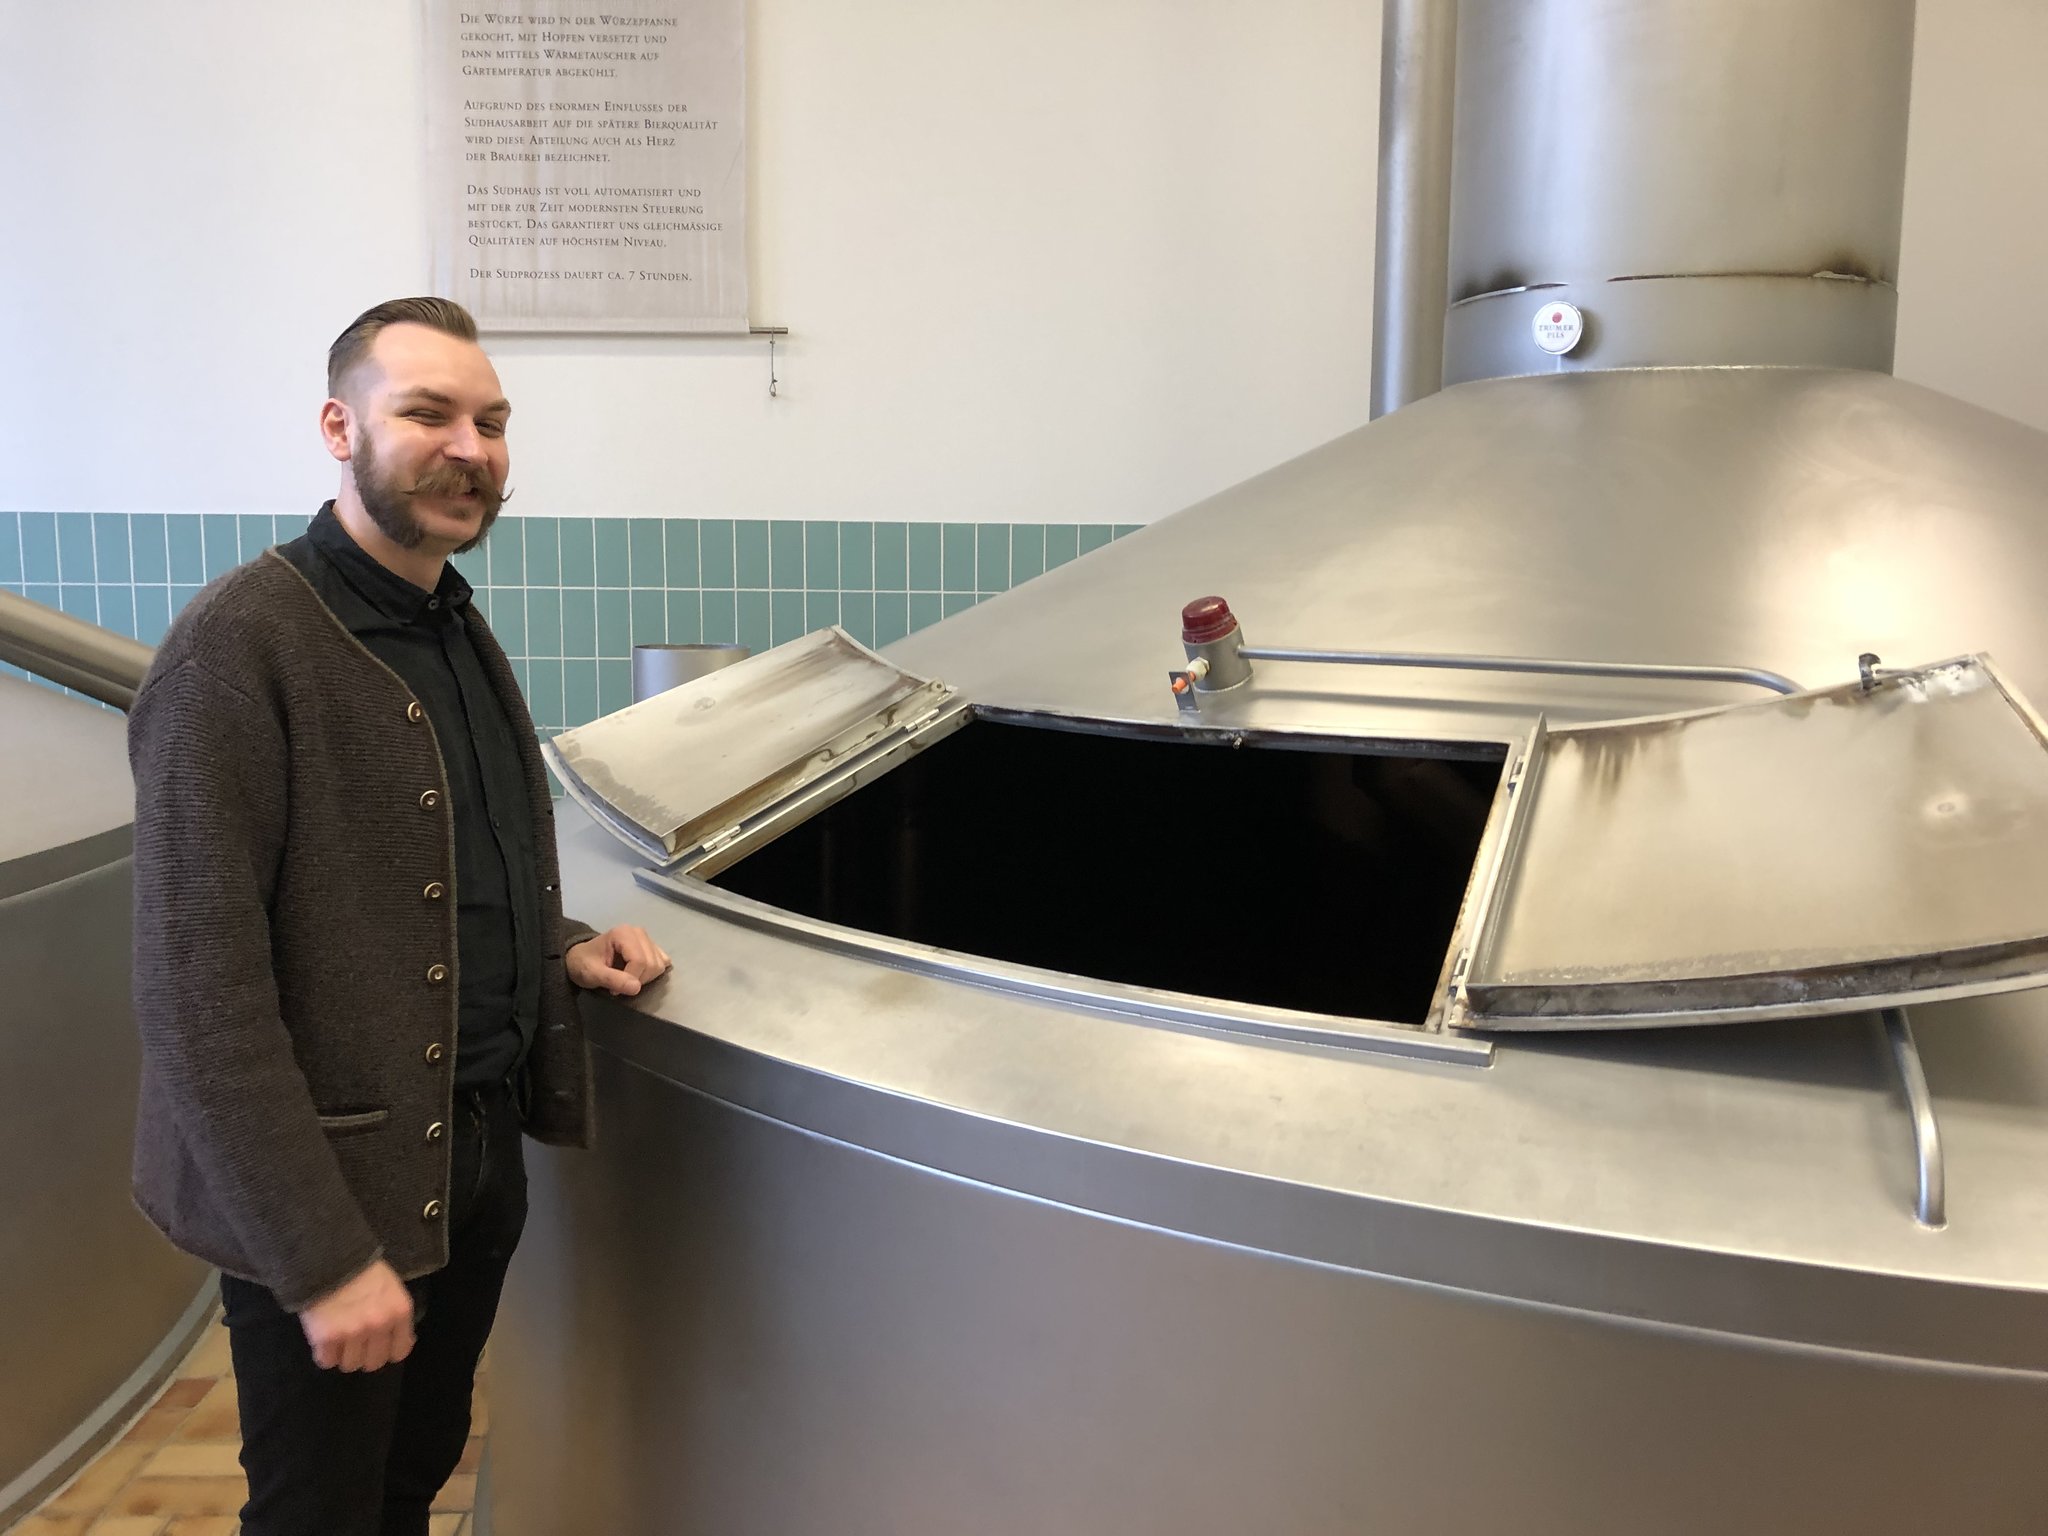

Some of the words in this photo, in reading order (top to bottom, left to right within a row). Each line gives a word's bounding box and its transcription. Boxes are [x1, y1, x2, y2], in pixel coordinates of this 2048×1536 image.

[461, 14, 479, 24] DIE
[560, 17, 570, 25] IN
[575, 17, 595, 25] DER
[518, 33, 537, 42] MIT
[542, 32, 585, 42] HOPFEN
[590, 35, 639, 43] VERSETZT
[644, 35, 667, 43] UND
[462, 50, 491, 58] DANN
[497, 51, 539, 59] MITTELS
[464, 100, 522, 111] AUFGRUND
[527, 102, 545, 111] DES
[550, 103, 599, 111] ENORMEN
[668, 104, 687, 112] DER
[553, 120, 572, 128] AUF
[576, 120, 593, 128] DIE
[465, 136, 492, 144] WIRD
[497, 136, 524, 144] DIESE
[592, 137, 620, 145] AUCH
[625, 137, 642, 145] ALS
[646, 136, 675, 146] HERZ
[490, 152, 540, 161] BRAUEREI
[467, 185, 488, 195] DAS
[492, 185, 541, 195] SUDHAUS
[545, 188, 560, 196] IST
[565, 188, 590, 196] VOLL
[679, 189, 701, 197] UND
[468, 204, 487, 212] MIT
[491, 204, 511, 212] DER
[516, 204, 535, 212] ZUR
[540, 203, 564, 212] ZEIT
[527, 219, 548, 229] DAS
[619, 222, 639, 230] UNS
[470, 269, 492, 278] DER
[564, 271, 604, 279] DAUERT
[629, 271, 635, 280] 7
